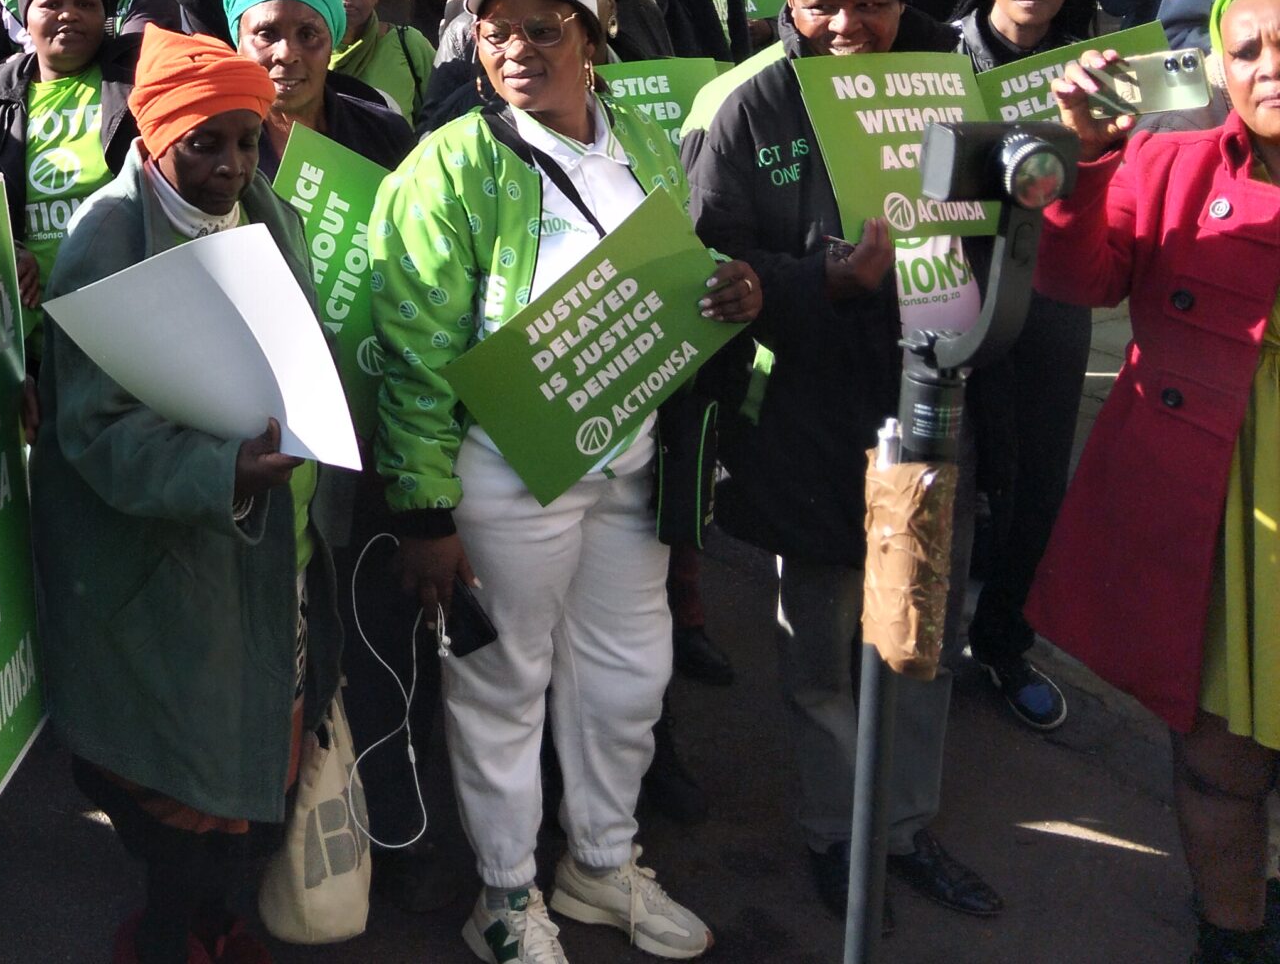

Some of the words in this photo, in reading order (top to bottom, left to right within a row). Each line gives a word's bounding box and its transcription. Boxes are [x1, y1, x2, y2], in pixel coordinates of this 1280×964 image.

[611, 75, 670, 98] STICE
[832, 75, 875, 100] NO
[885, 72, 966, 97] JUSTICE
[1001, 64, 1065, 98] JUSTI
[856, 107, 964, 134] WITHOUT
[1000, 91, 1058, 122] DELA
[791, 138, 810, 158] AS
[881, 143, 921, 170] ACT
[771, 163, 801, 186] ONE
[916, 200, 985, 223] ACTIONSA
[312, 191, 350, 285] HOUT
[524, 258, 618, 345] JUSTICE
[531, 277, 638, 373] DELAYED
[539, 372, 568, 401] IS
[573, 290, 663, 376] JUSTICE
[567, 321, 665, 413] DENIED!
[612, 340, 699, 426] ACTIONSA
